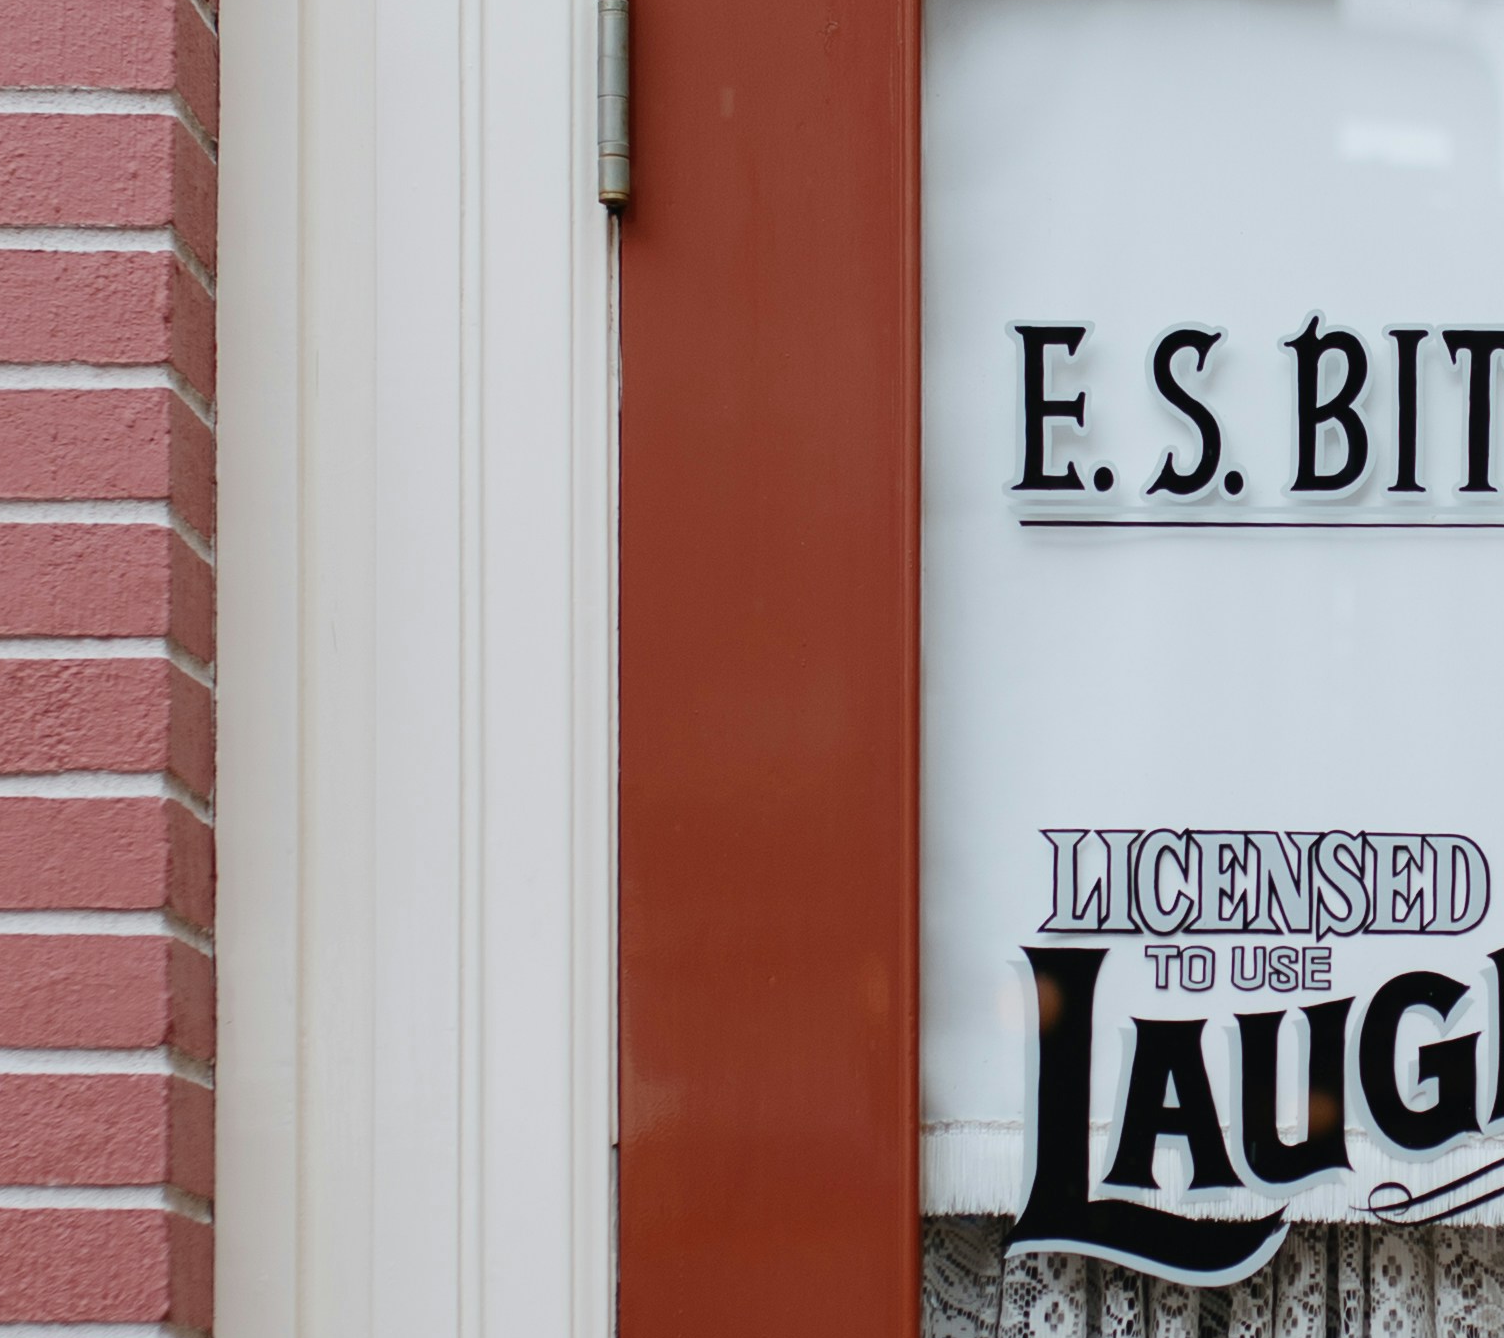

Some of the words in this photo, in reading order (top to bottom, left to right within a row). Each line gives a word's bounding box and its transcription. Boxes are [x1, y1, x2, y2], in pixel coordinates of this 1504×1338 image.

[1011, 323, 1115, 495] E.
[1146, 326, 1244, 497] S.
[1037, 828, 1492, 941] LICENSED
[1144, 944, 1216, 993] TO
[1230, 944, 1333, 993] USE
